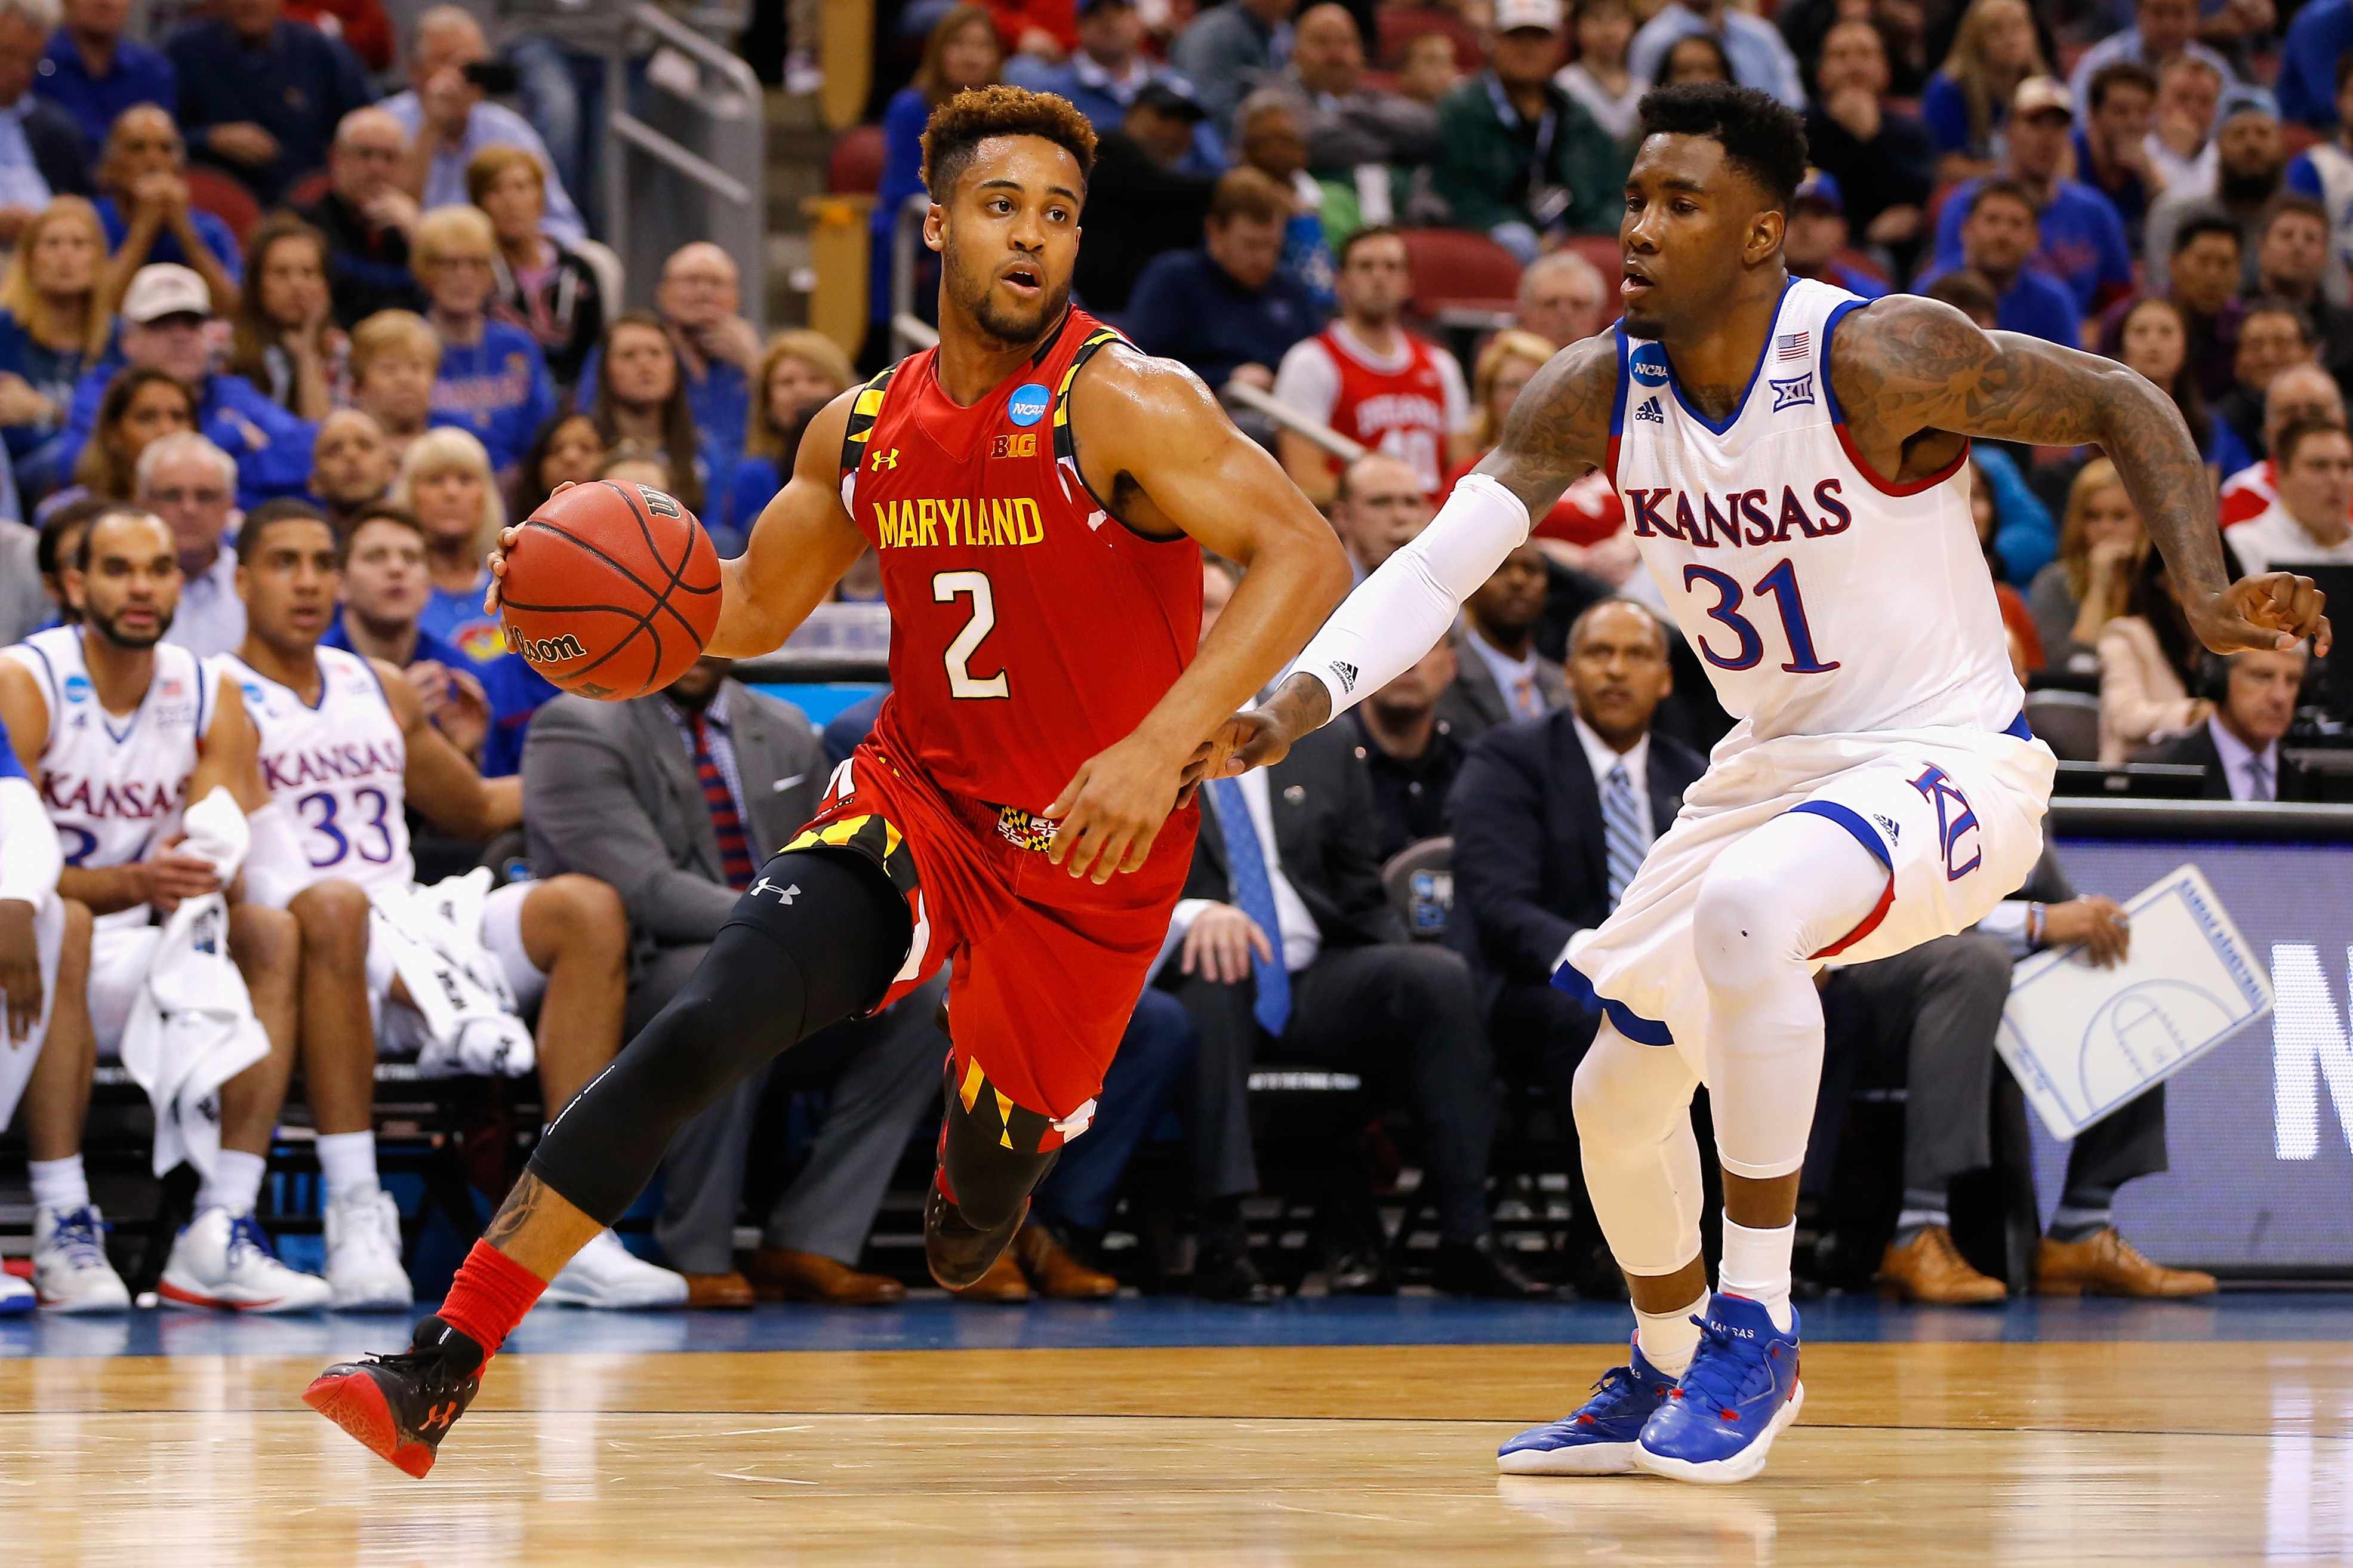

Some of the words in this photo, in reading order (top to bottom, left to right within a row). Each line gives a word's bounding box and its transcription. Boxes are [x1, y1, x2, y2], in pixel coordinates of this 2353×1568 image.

[1012, 402, 1047, 416] NCAA
[1635, 410, 1664, 424] adidas
[872, 497, 1045, 550] MARYLAND
[1625, 479, 1852, 548] KANSAS
[931, 569, 1011, 700] 2
[1683, 557, 1841, 674] 31
[1332, 660, 1354, 691] adidas
[298, 786, 392, 868] 33
[1872, 813, 1899, 848] adidas
[1905, 763, 1982, 882] KU
